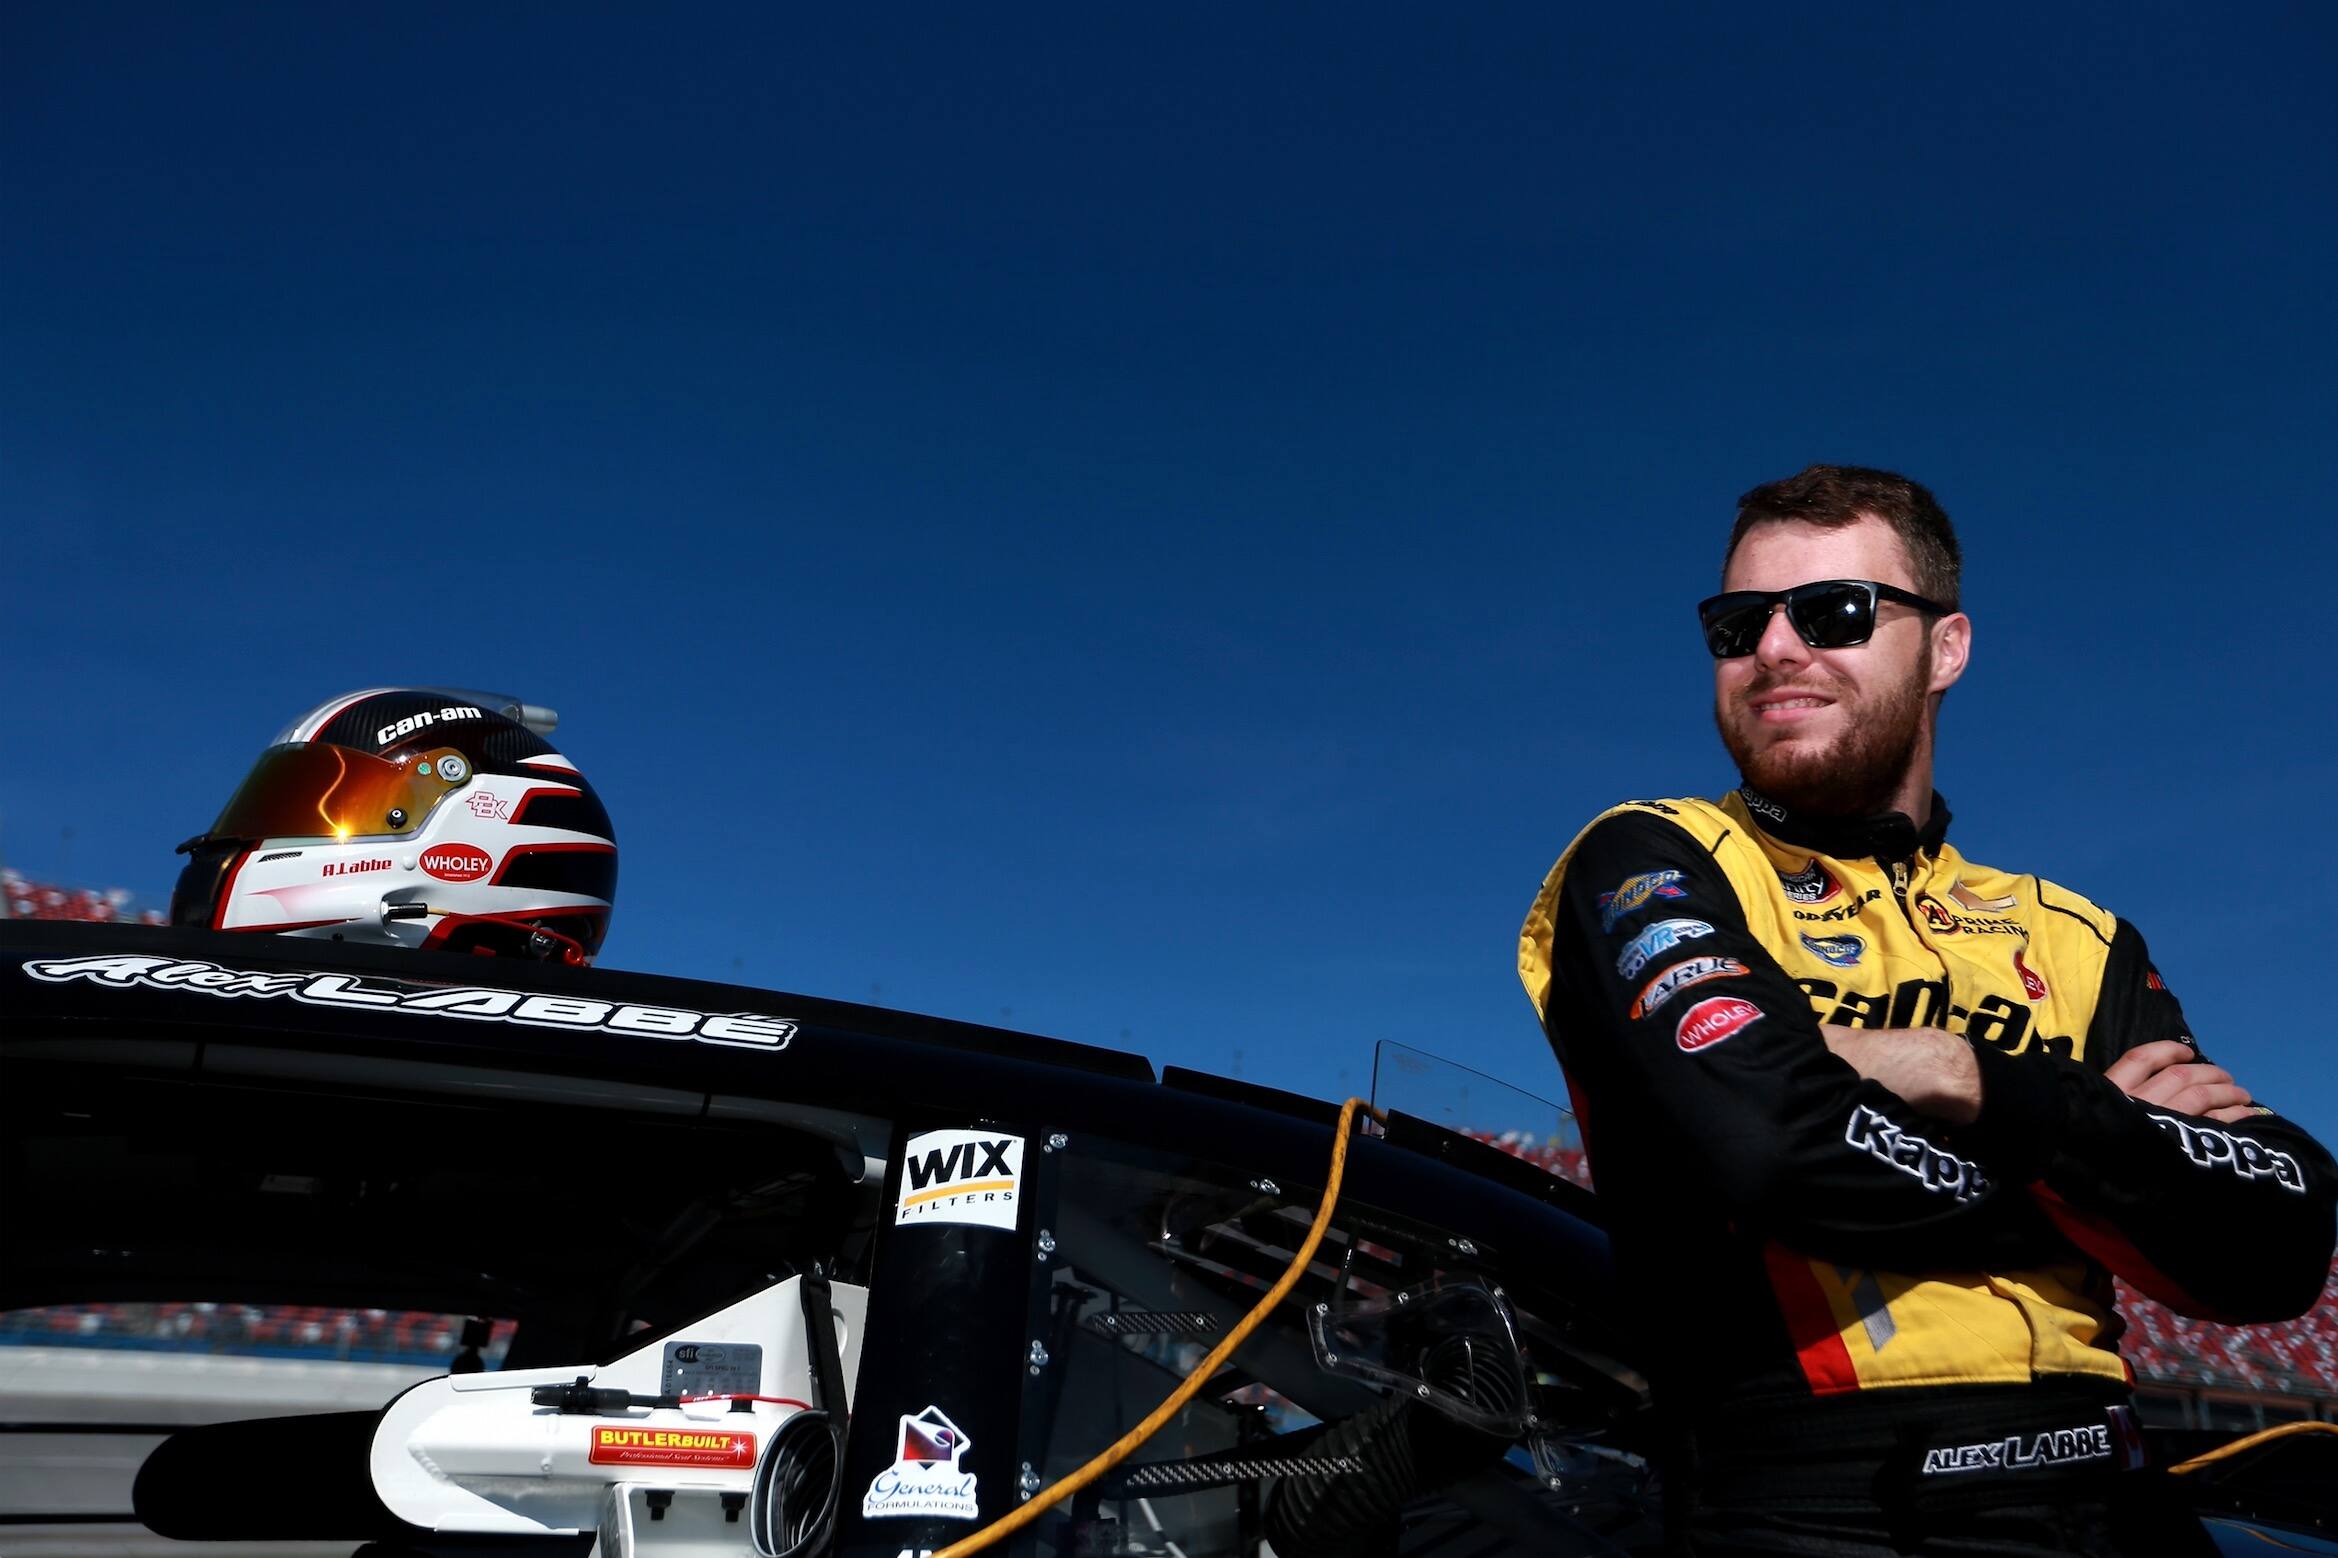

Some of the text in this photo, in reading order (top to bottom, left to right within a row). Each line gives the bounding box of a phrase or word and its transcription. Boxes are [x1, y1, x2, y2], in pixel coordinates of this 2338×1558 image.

[377, 707, 482, 746] can-am
[1743, 786, 1787, 822] appa
[424, 855, 488, 872] WHOLEY
[1793, 889, 1882, 922] ODYEAR
[1682, 1004, 1757, 1046] WHOLEY
[1798, 977, 2074, 1060] can-a
[907, 1140, 1014, 1190] WIX
[1845, 1104, 1990, 1202] Kapp
[2146, 1112, 2306, 1193] appa
[902, 1191, 1014, 1219] FILTERS
[600, 1430, 731, 1449] BUTLERBUILT
[1922, 1443, 2003, 1473] ALEX
[868, 1470, 972, 1503] General
[867, 1500, 974, 1513] FORMULATIONS
